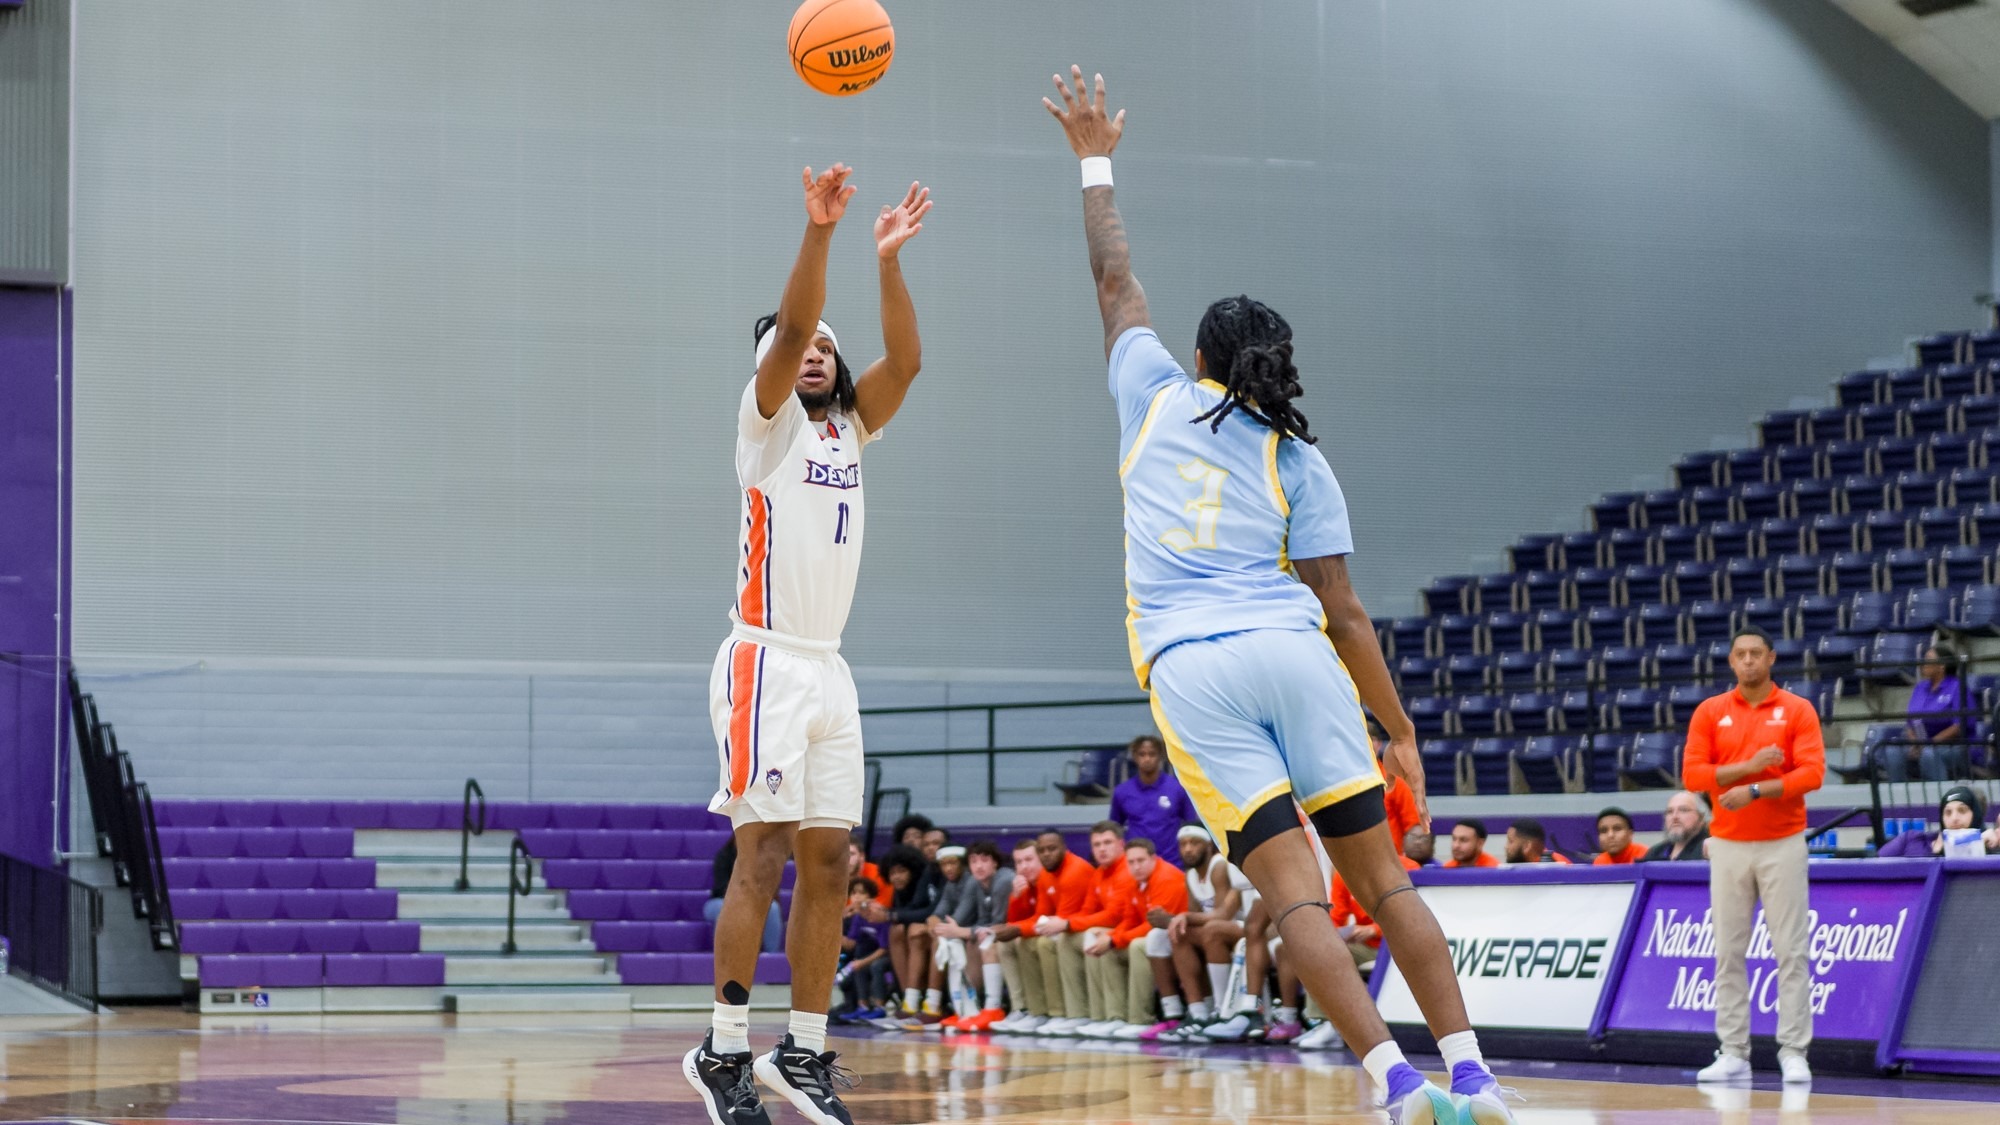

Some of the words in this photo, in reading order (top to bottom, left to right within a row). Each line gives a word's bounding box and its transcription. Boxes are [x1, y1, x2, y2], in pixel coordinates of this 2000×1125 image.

[827, 41, 891, 68] Wilson
[1158, 457, 1229, 551] 3
[1447, 938, 1608, 978] WERADE
